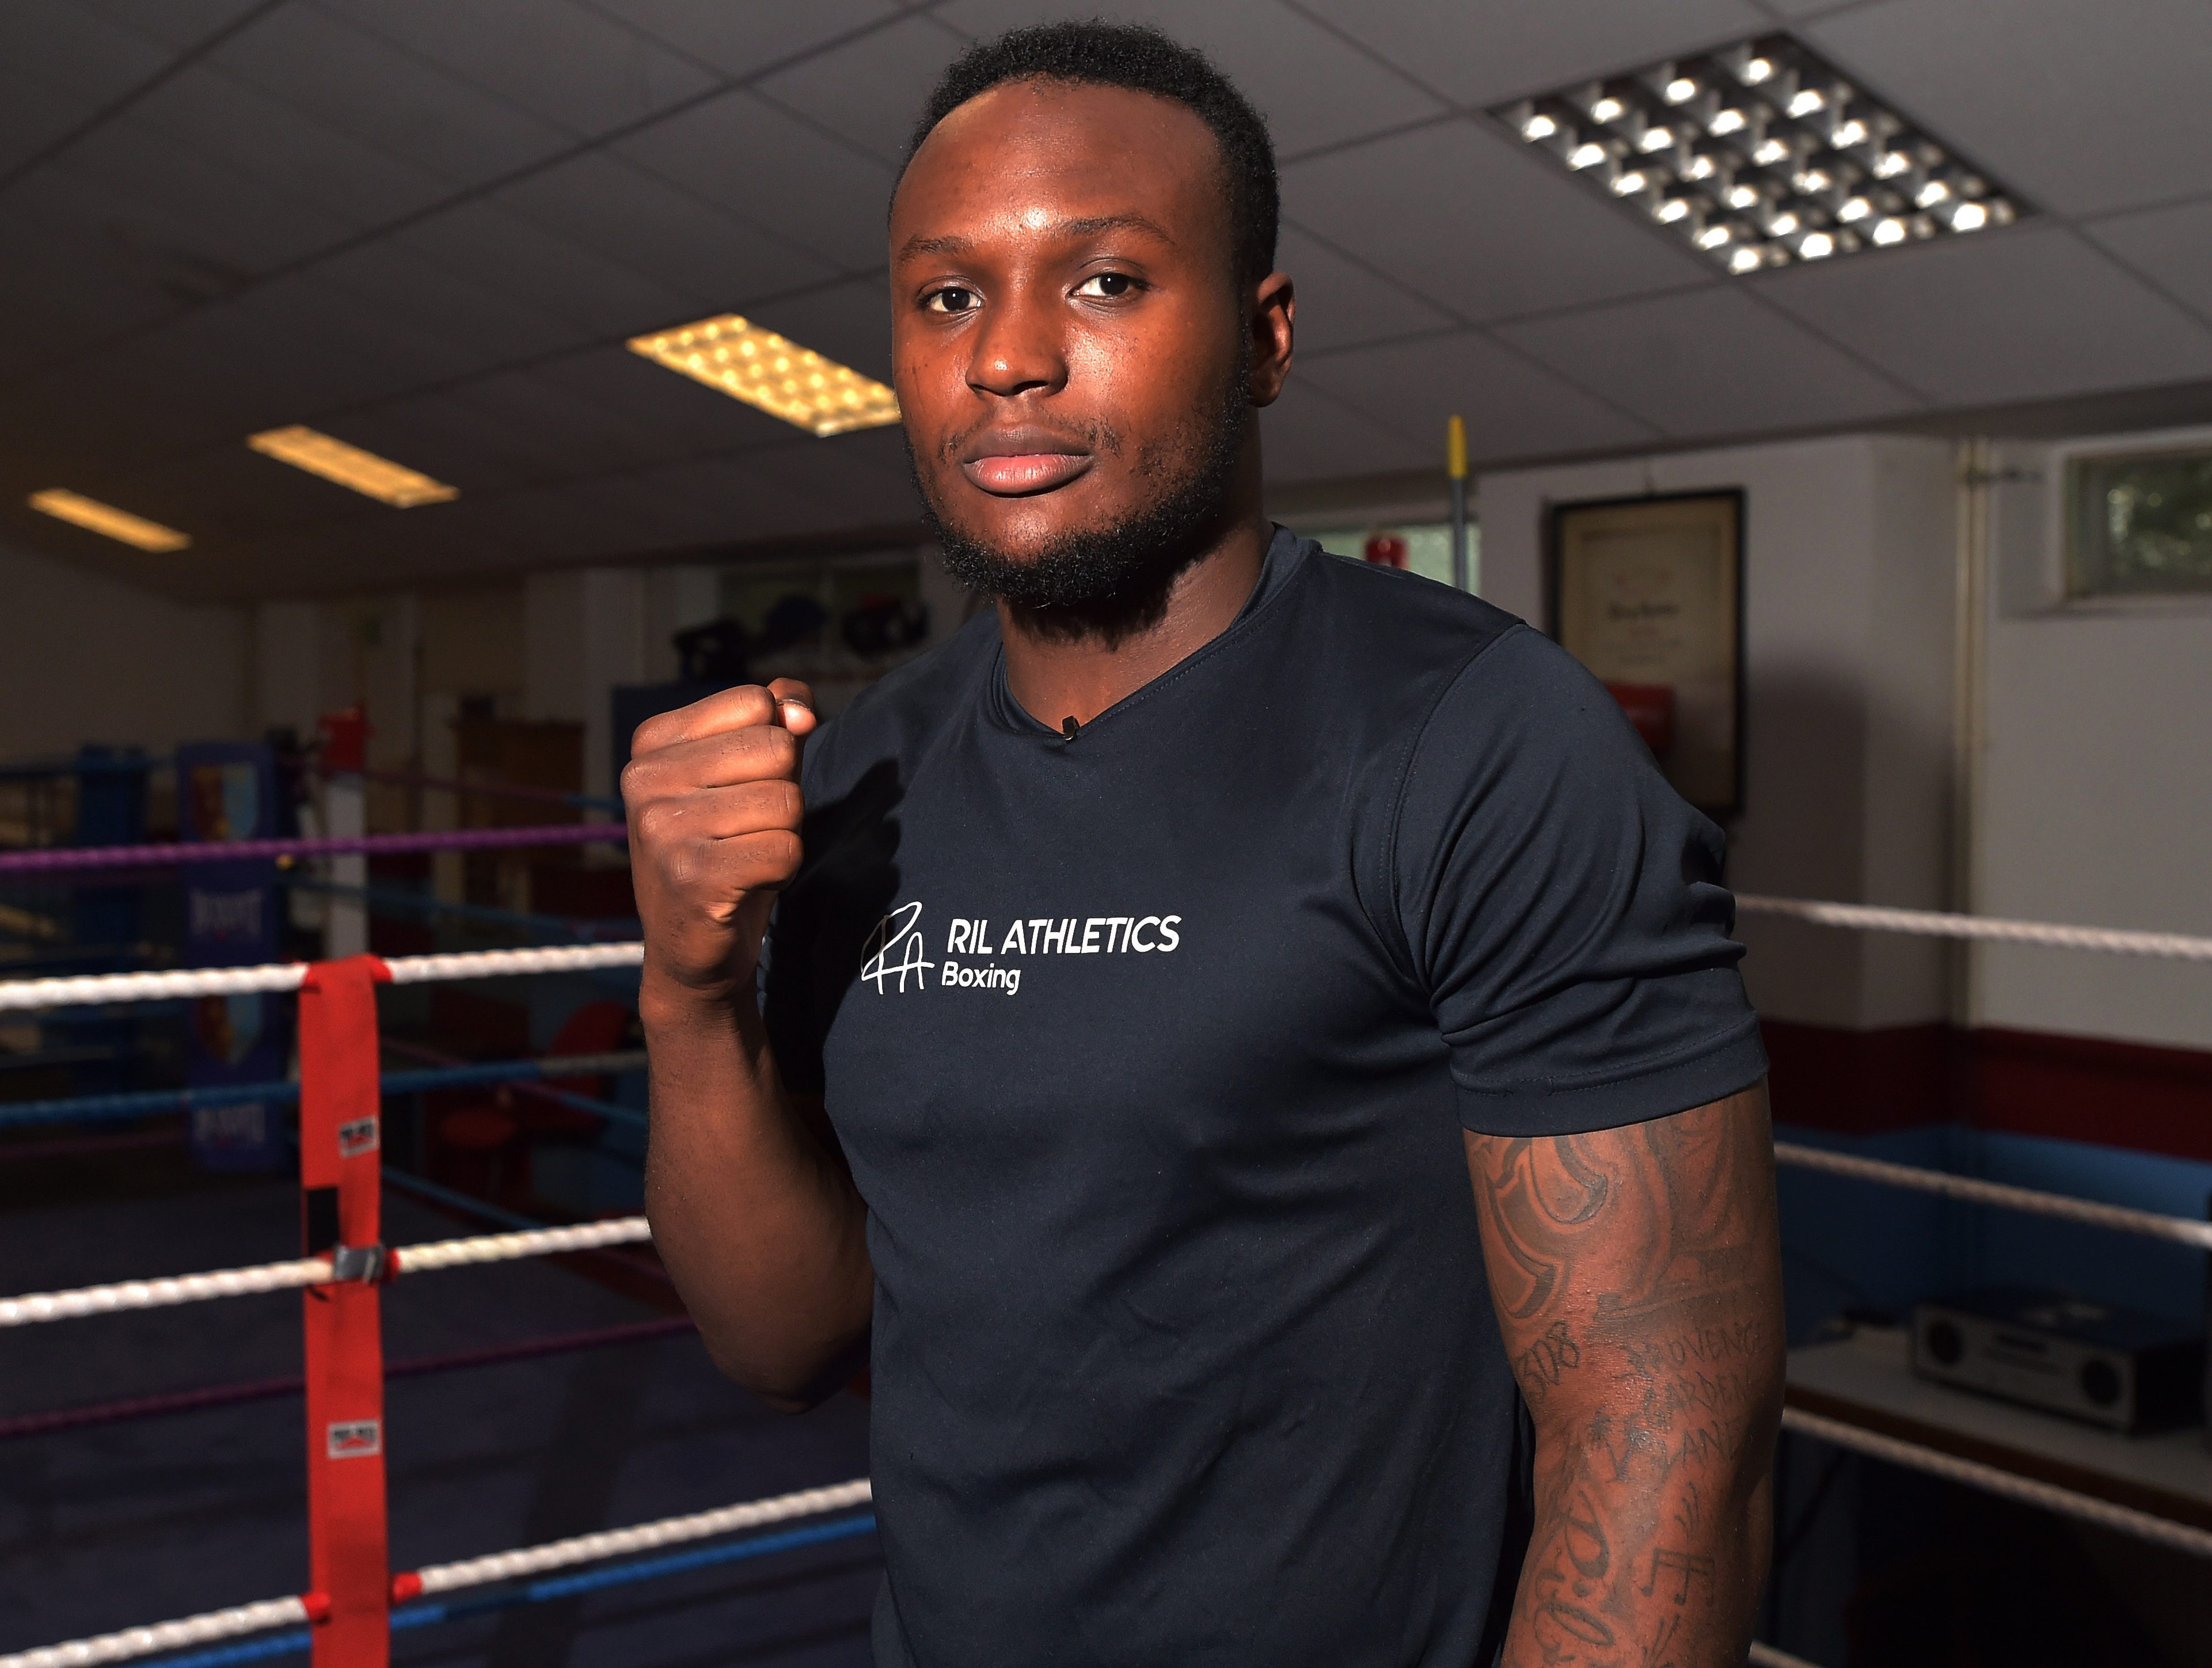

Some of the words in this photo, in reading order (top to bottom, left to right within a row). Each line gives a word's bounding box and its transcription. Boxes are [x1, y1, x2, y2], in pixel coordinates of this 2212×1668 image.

[947, 918, 993, 955] RIL
[1000, 915, 1182, 955] ATHLETICS
[941, 961, 1021, 996] Boxing
